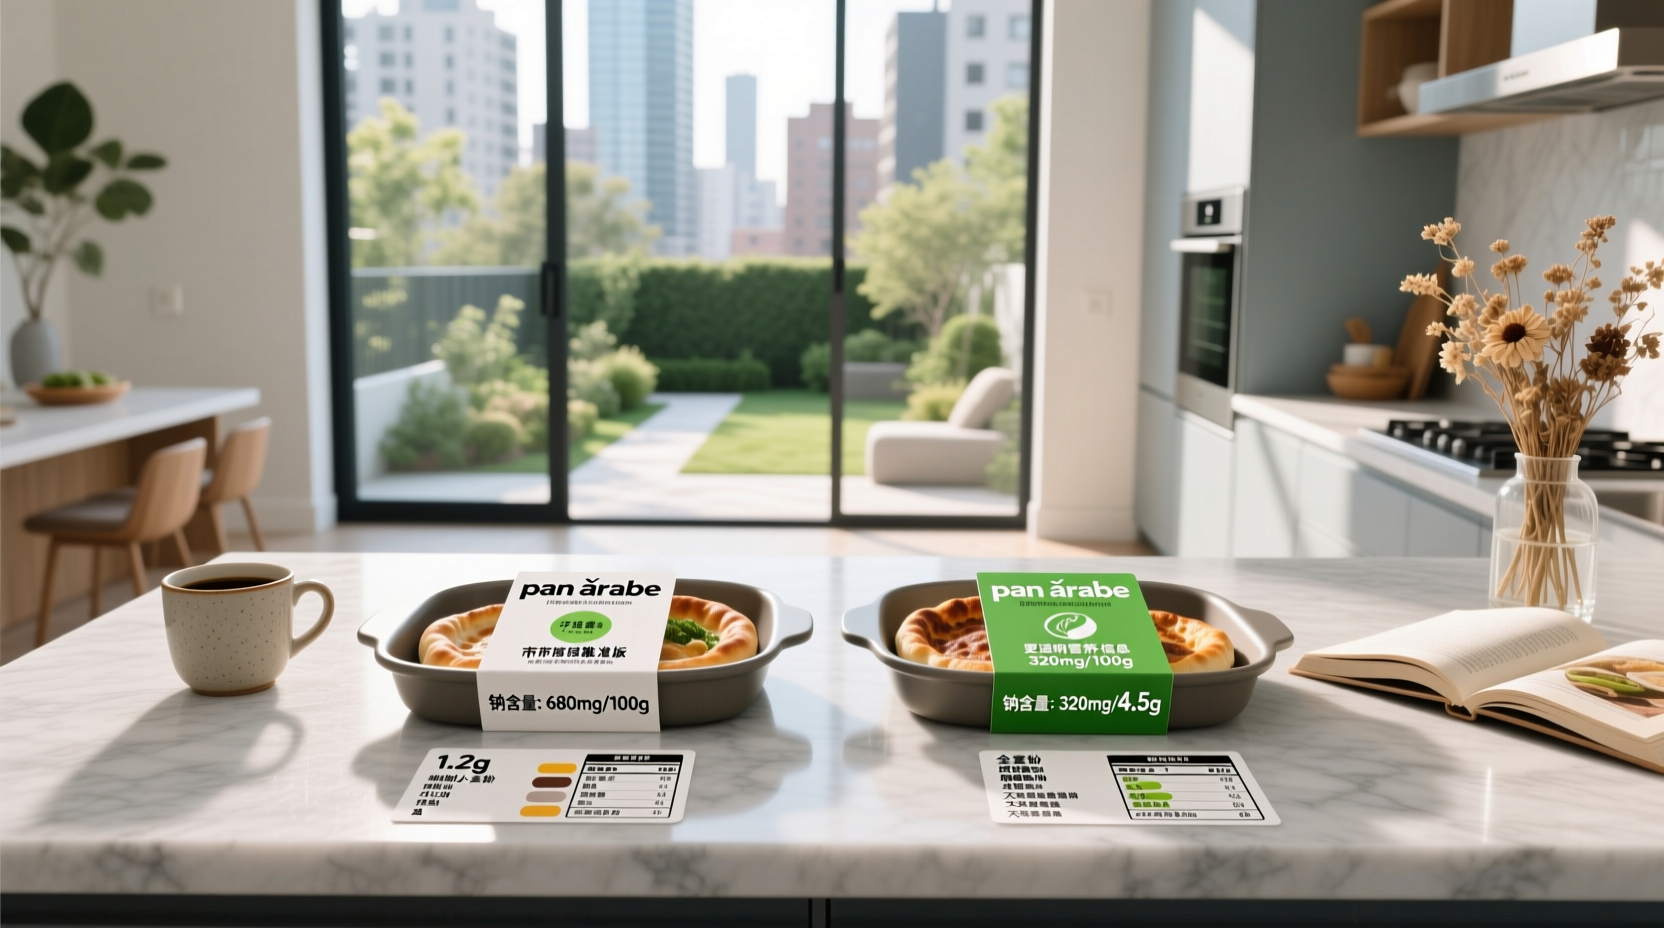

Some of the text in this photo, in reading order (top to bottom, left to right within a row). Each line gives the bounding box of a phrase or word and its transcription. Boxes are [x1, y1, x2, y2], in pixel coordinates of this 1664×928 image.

[519, 583, 575, 600] pan
[991, 584, 1045, 602] pan
[1028, 655, 1133, 669] 320mg/100g
[546, 694, 650, 715] 680mg/100g
[1058, 691, 1162, 716] 320mg/4.5g
[437, 754, 491, 774] 1.2g
